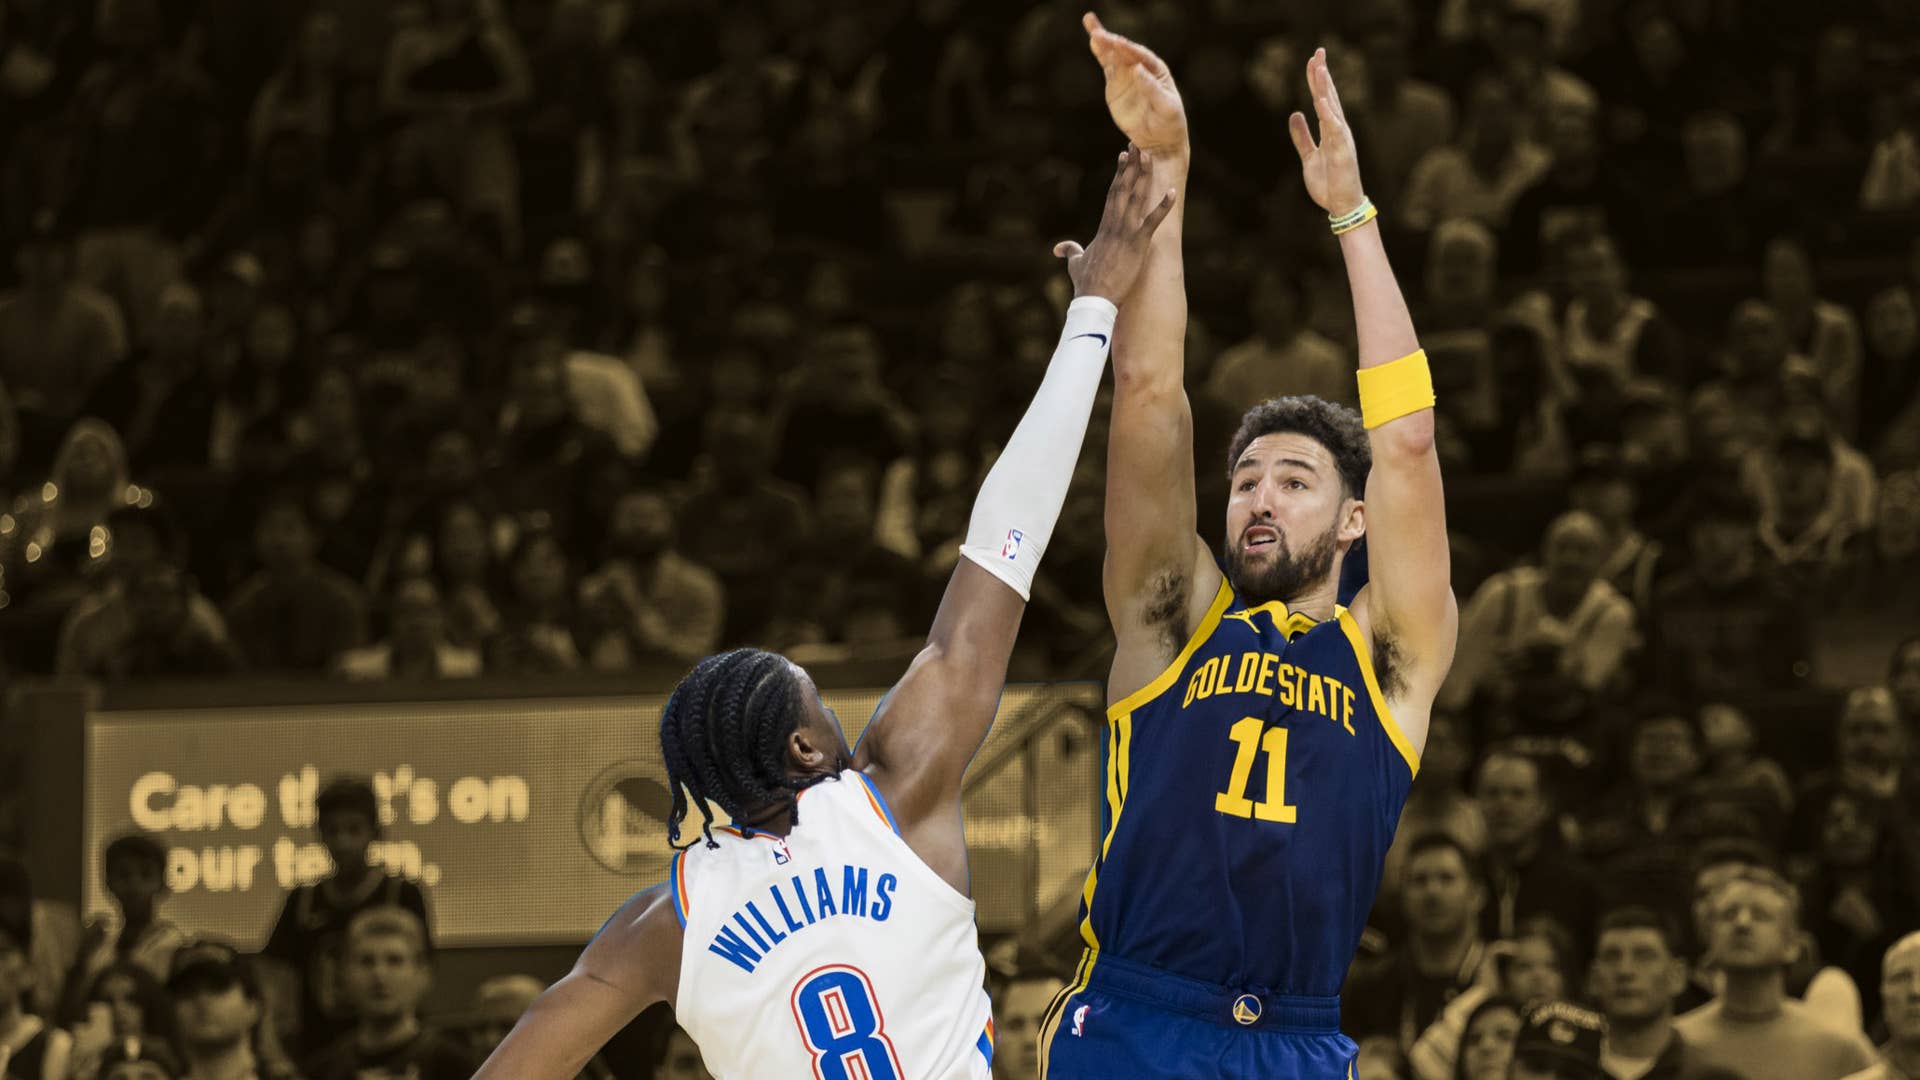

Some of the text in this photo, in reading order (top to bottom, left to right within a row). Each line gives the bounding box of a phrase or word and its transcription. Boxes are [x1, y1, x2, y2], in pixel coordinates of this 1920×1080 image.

[1182, 651, 1356, 737] GOLDE STATE
[130, 771, 266, 831] Care
[448, 774, 529, 824] on
[1214, 716, 1297, 824] 11
[166, 836, 441, 893] our tem.
[708, 865, 897, 974] WILLIAMS
[791, 963, 906, 1080] 8
